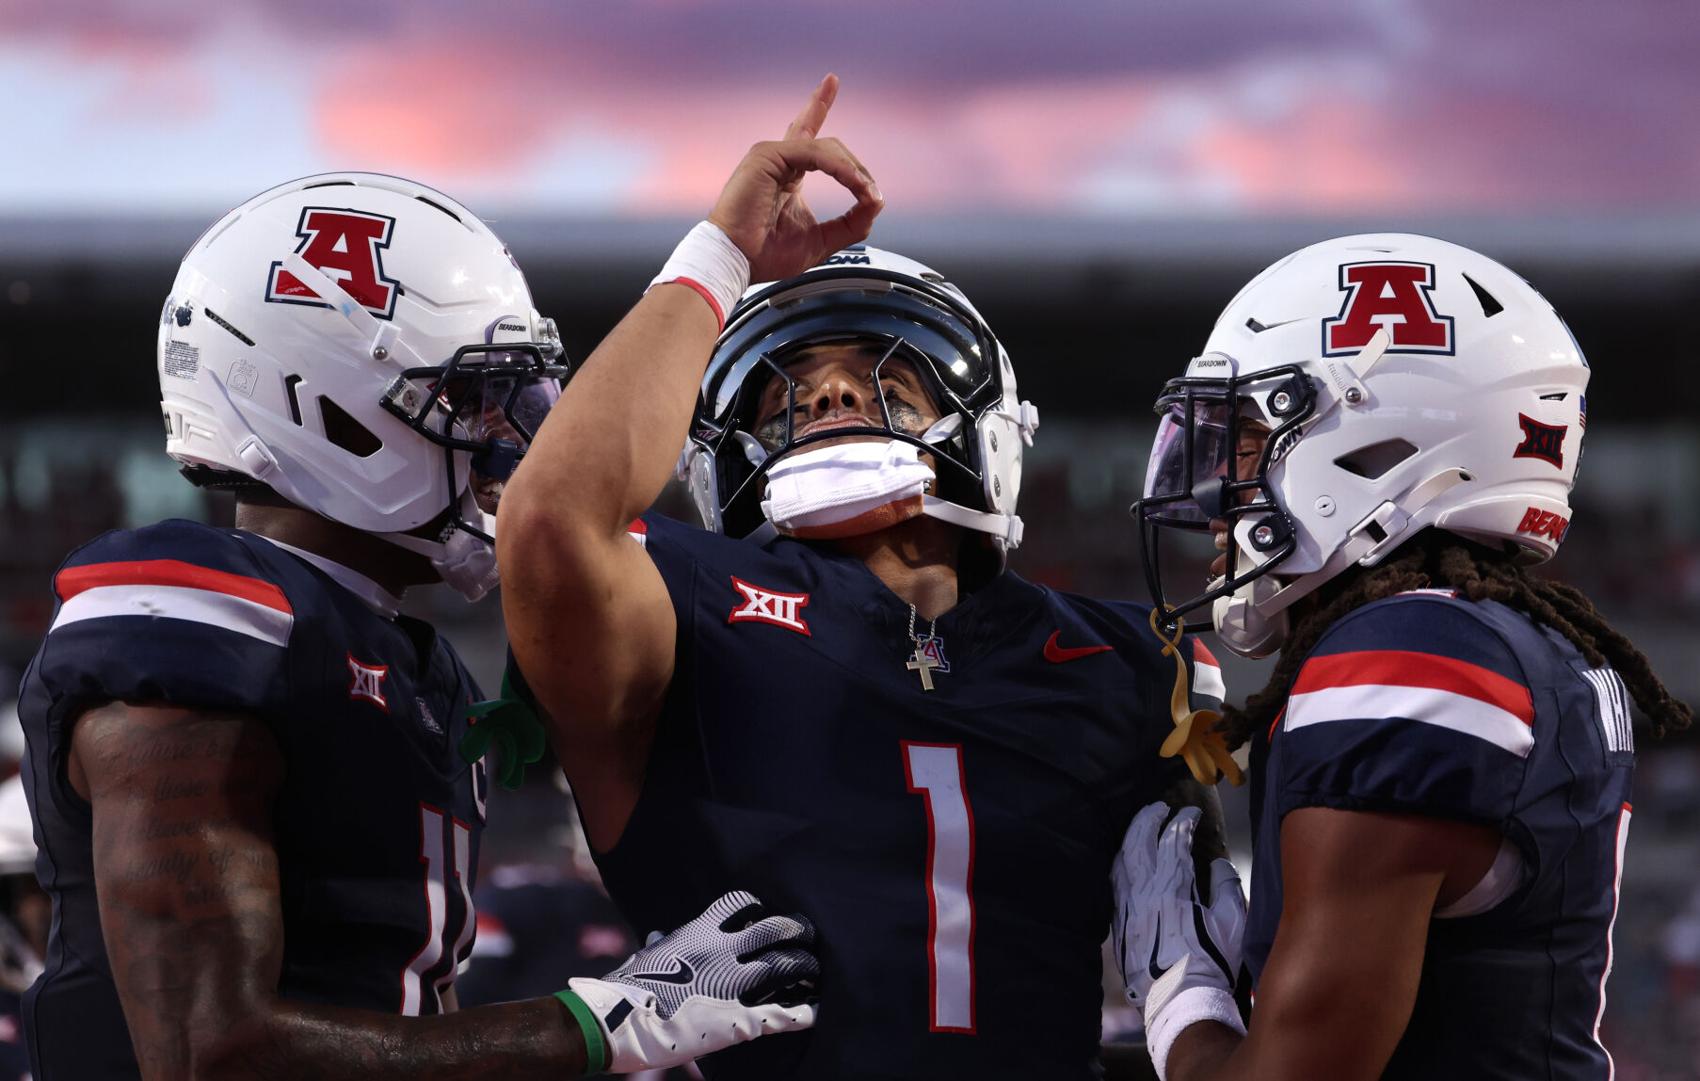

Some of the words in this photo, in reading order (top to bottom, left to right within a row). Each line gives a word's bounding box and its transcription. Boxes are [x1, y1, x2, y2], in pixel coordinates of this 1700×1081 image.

[264, 206, 400, 320] A
[1322, 260, 1456, 357] A
[732, 578, 809, 633] XII
[348, 655, 389, 710] XII
[400, 801, 477, 1017] 11
[903, 740, 977, 1032] 1
